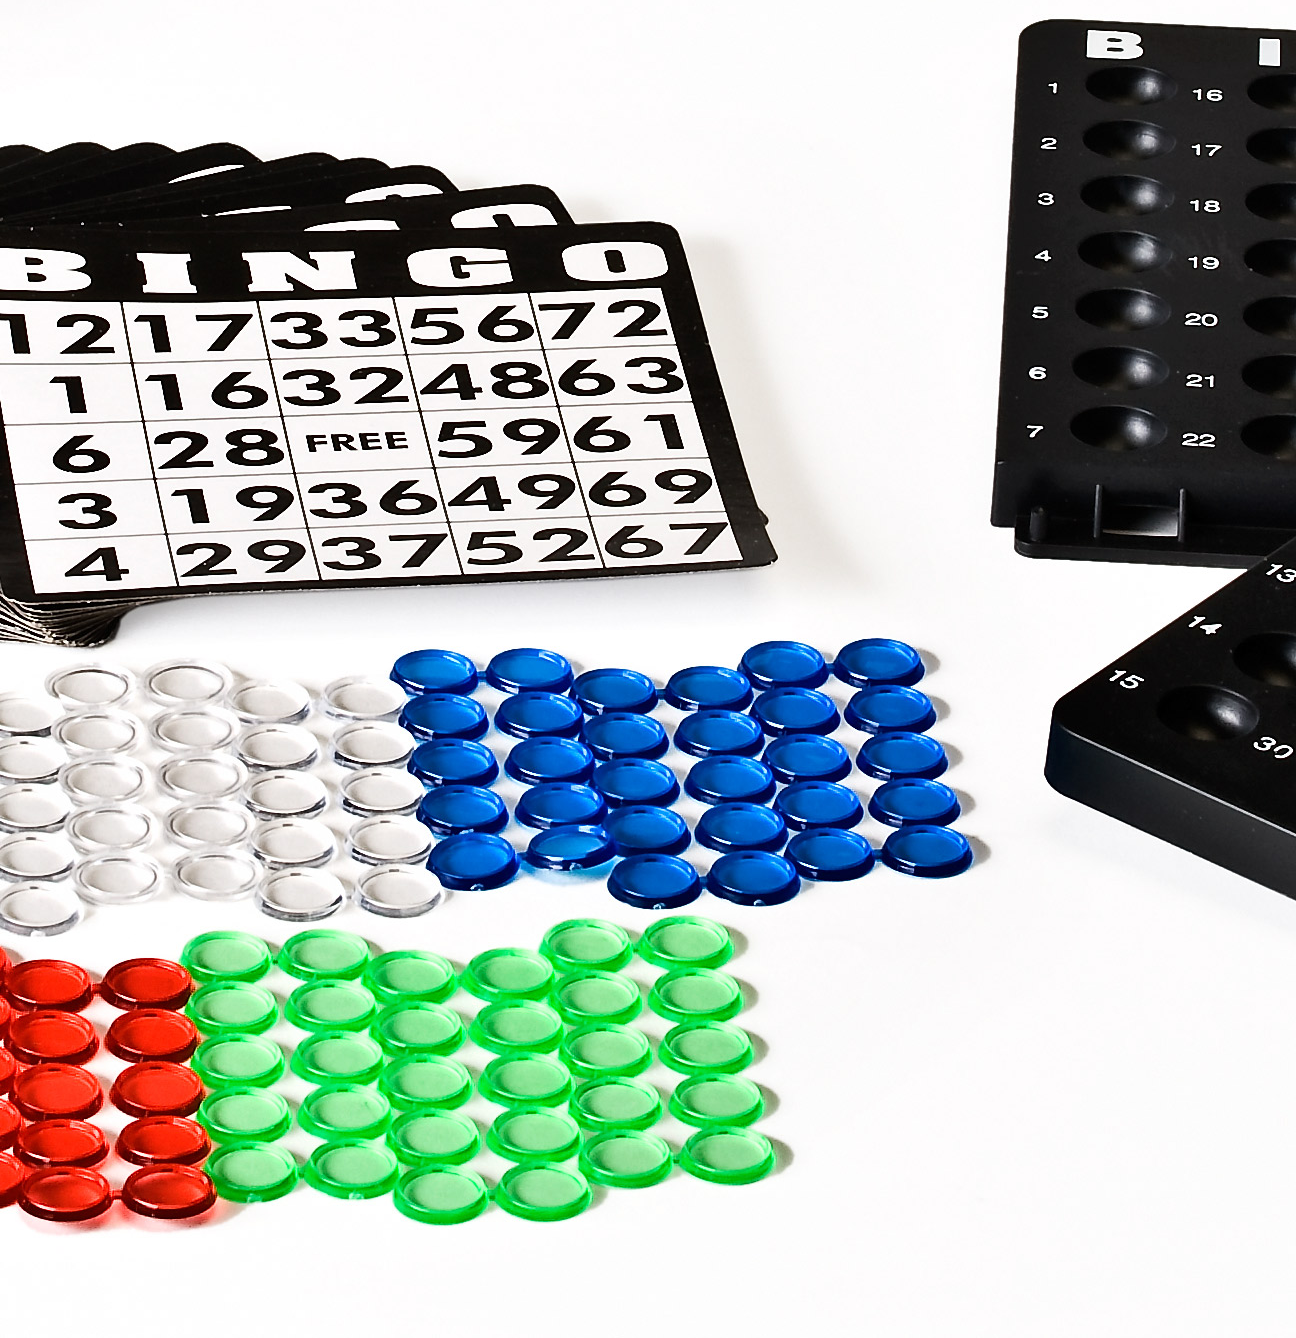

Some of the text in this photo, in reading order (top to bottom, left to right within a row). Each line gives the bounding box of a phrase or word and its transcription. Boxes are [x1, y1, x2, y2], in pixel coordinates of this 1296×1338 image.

[1086, 29, 1144, 60] B
[1258, 37, 1281, 67] I
[1048, 82, 1058, 94] 1
[1192, 88, 1223, 102] 16
[1040, 137, 1057, 150] 2
[1191, 143, 1223, 157] 17
[1037, 192, 1055, 206] 3
[1189, 199, 1221, 213] 18
[1034, 249, 1052, 262] 4
[1187, 256, 1220, 270] 19
[133, 313, 254, 354] 17
[270, 309, 397, 350] 33
[410, 304, 535, 346] 56
[537, 299, 669, 341] 72
[1031, 306, 1049, 319] 5
[1184, 312, 1218, 327] 20
[49, 356, 685, 414] 1 16 32 48 63
[1028, 366, 1047, 380] 6
[1185, 373, 1215, 388] 21
[52, 413, 685, 474] 6 28 FREE 59 61
[1026, 424, 1044, 438] 7
[1181, 432, 1216, 448] 22
[57, 468, 713, 530] 3 19 36 49 69
[64, 521, 729, 582] 4 29 37 52 67
[1188, 615, 1223, 635] 14
[1109, 669, 1145, 689] 15
[1253, 736, 1294, 759] 30
